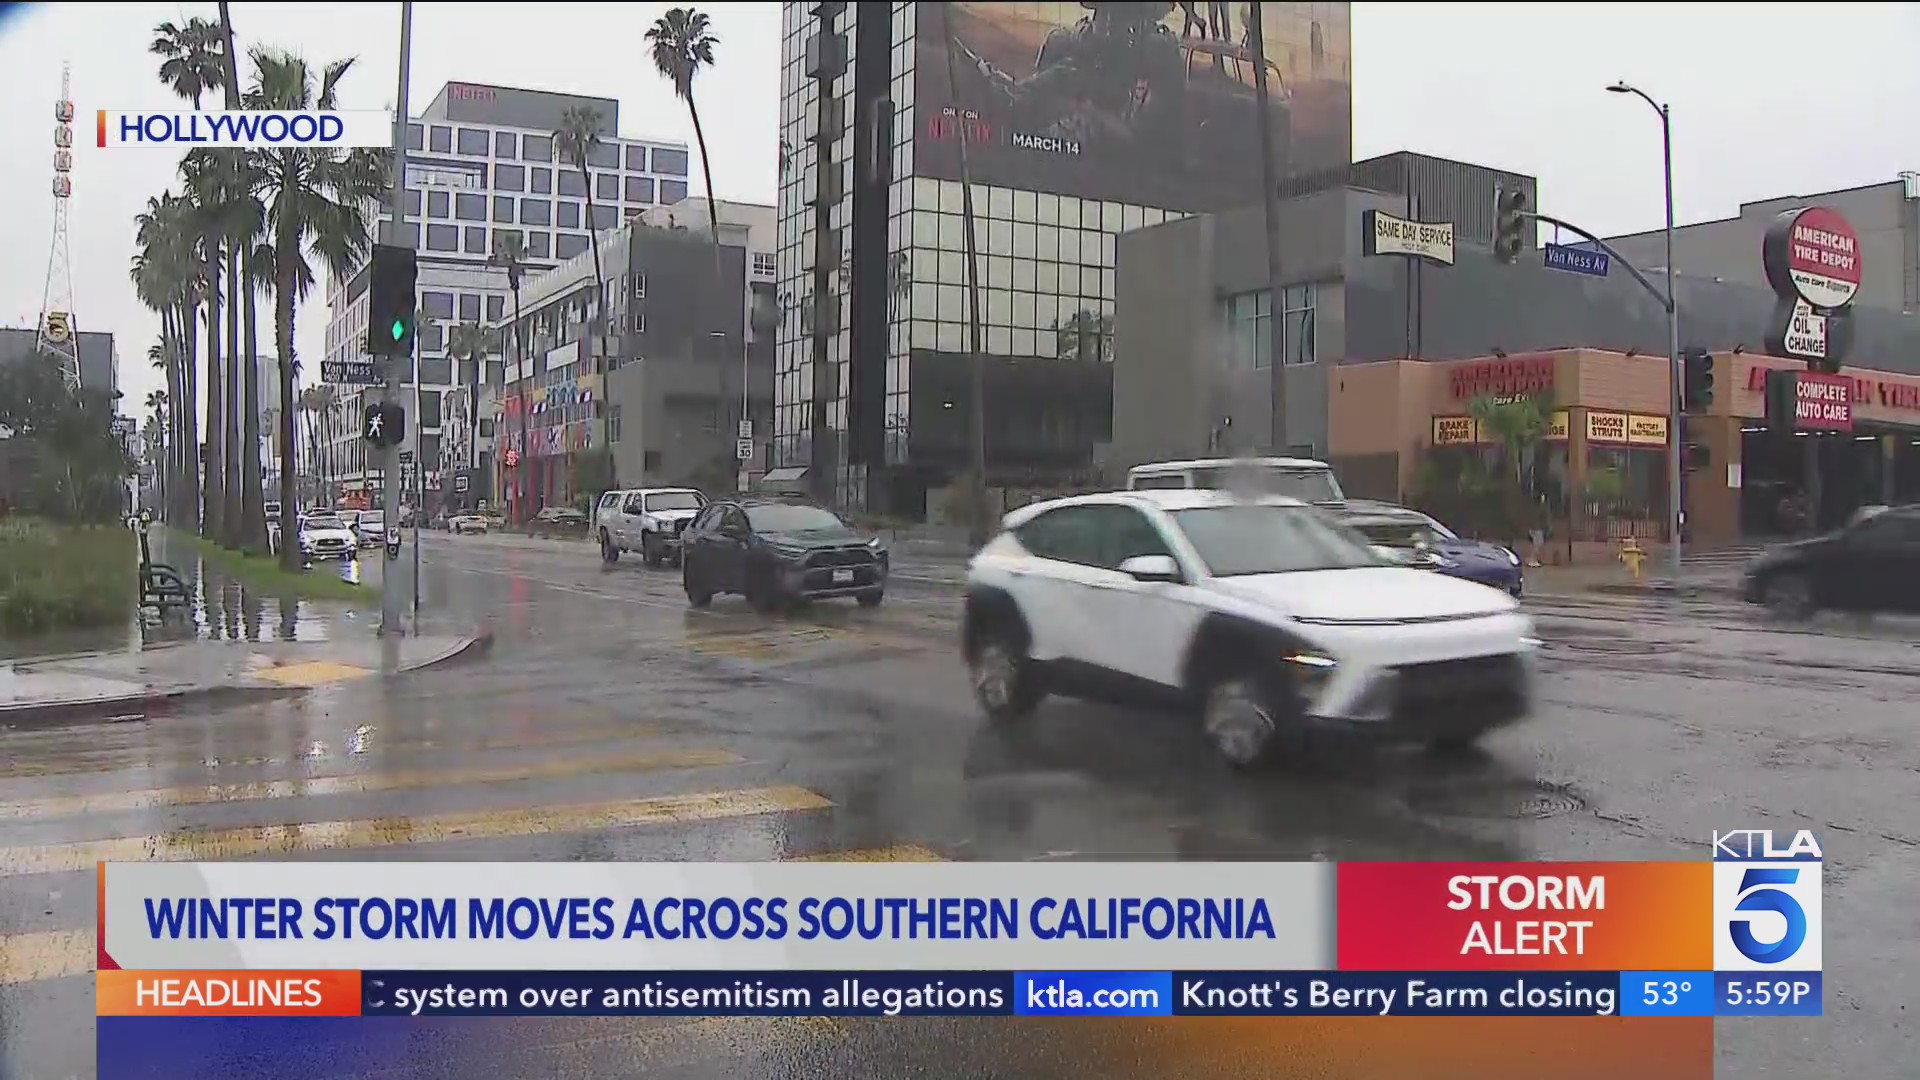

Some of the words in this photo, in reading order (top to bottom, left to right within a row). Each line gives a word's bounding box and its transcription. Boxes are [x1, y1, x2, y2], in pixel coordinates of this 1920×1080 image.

[1012, 132, 1062, 153] MARCH
[1065, 140, 1081, 155] 14
[1377, 219, 1400, 238] SAME
[1402, 223, 1417, 241] DAY
[1419, 226, 1452, 247] SERVICE
[1794, 225, 1854, 253] AMERICAN
[1548, 248, 1565, 264] Van
[1567, 251, 1591, 268] Ness
[1593, 255, 1606, 271] Av
[1794, 244, 1819, 263] TIRE
[1820, 250, 1855, 270] DEPOT
[1793, 316, 1811, 334] OIL
[1788, 336, 1824, 353] CHANGE
[324, 361, 342, 374] Van
[346, 362, 371, 376] Ness
[1796, 381, 1847, 402] COMPLETE
[1795, 400, 1821, 418] AUTO
[1823, 404, 1848, 421] CARE
[1439, 420, 1469, 430] BRAKE
[1591, 415, 1624, 428] SHOCKS
[1439, 429, 1469, 441] REPAIR
[1592, 426, 1623, 438] STRUTS
